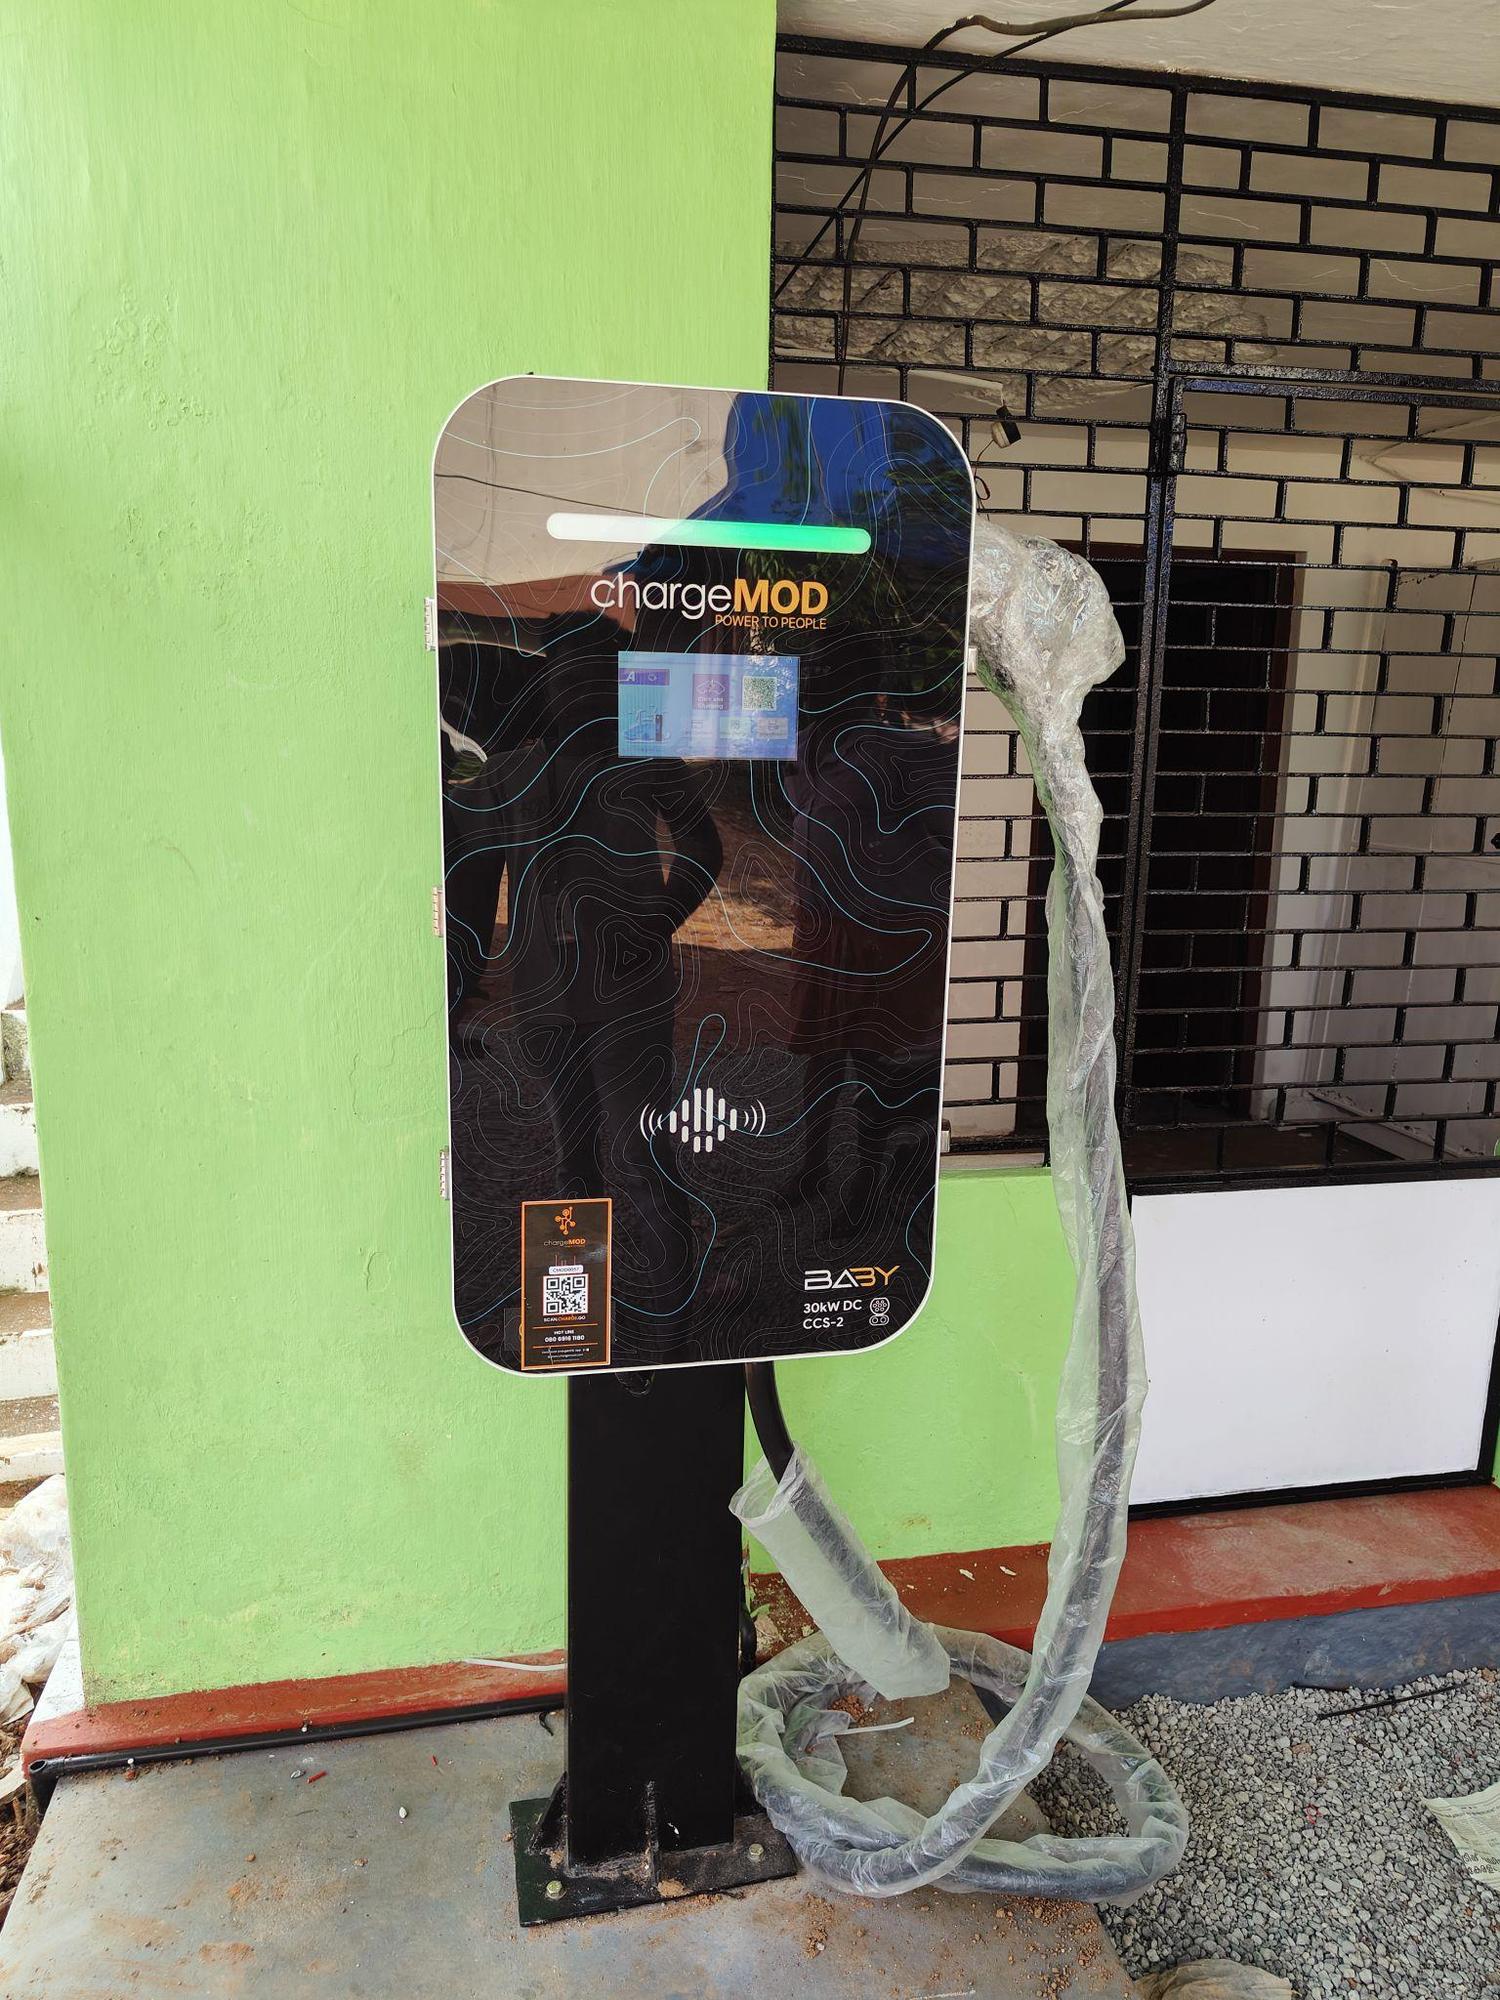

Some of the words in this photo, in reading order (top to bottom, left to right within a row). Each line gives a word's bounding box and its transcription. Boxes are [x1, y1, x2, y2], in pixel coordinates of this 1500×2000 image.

[590, 572, 829, 620] chargeMOD
[715, 614, 759, 628] POWER
[762, 616, 779, 628] TO
[781, 617, 827, 630] PEOPLE
[543, 1239, 586, 1247] chargeMOD
[804, 1265, 900, 1290] BABY
[803, 1301, 841, 1314] 30kW
[843, 1299, 863, 1311] DC
[802, 1316, 844, 1330] CCS-2
